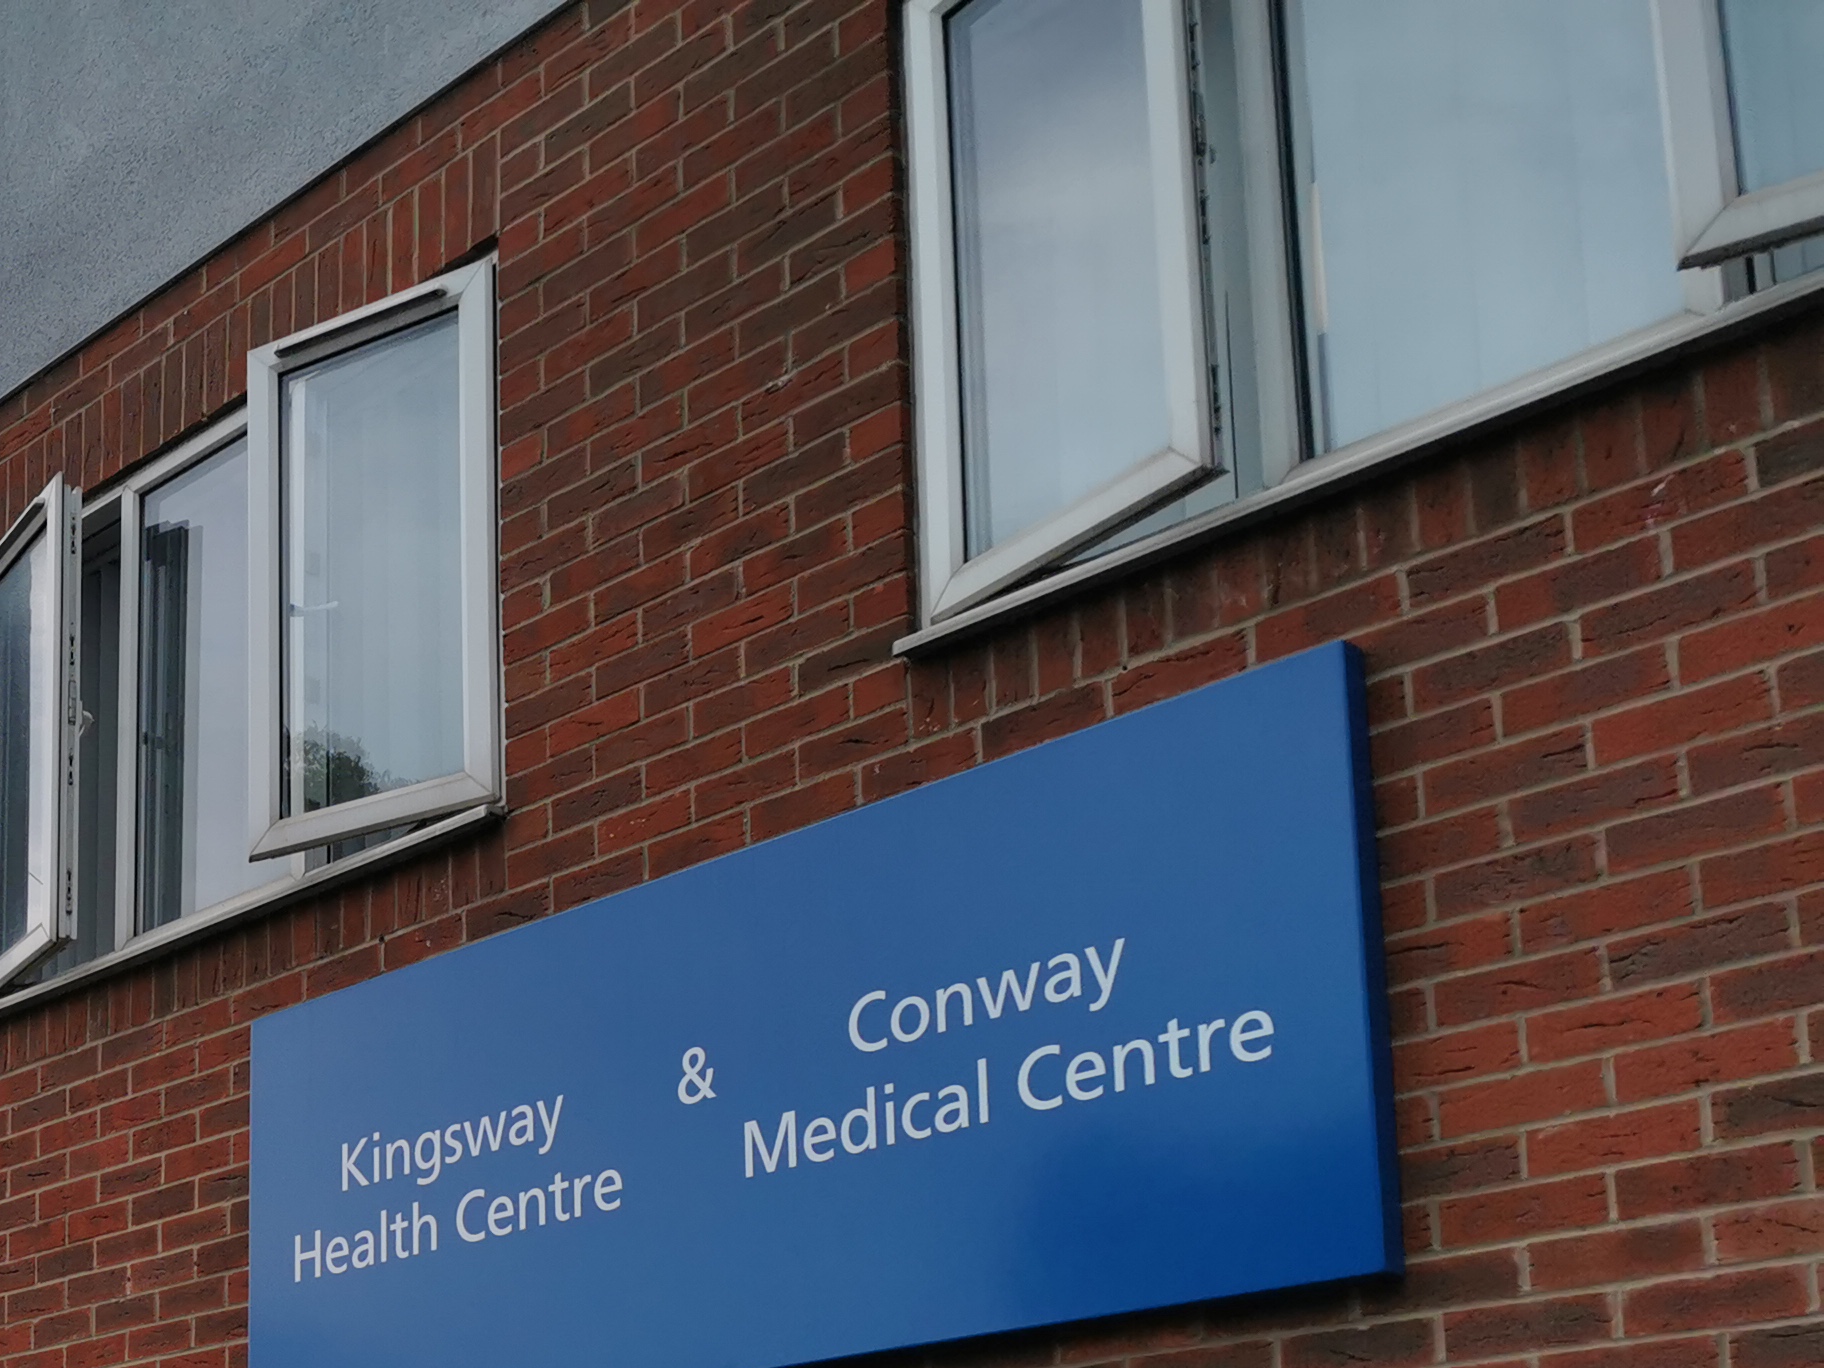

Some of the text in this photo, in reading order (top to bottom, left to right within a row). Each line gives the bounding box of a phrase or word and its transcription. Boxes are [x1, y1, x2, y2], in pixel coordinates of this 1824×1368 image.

[847, 938, 1126, 1053] Conway
[676, 1046, 718, 1106] &
[742, 1010, 1276, 1179] Medical Centre
[340, 1093, 565, 1193] Kingsway
[293, 1168, 624, 1284] Health Centre
